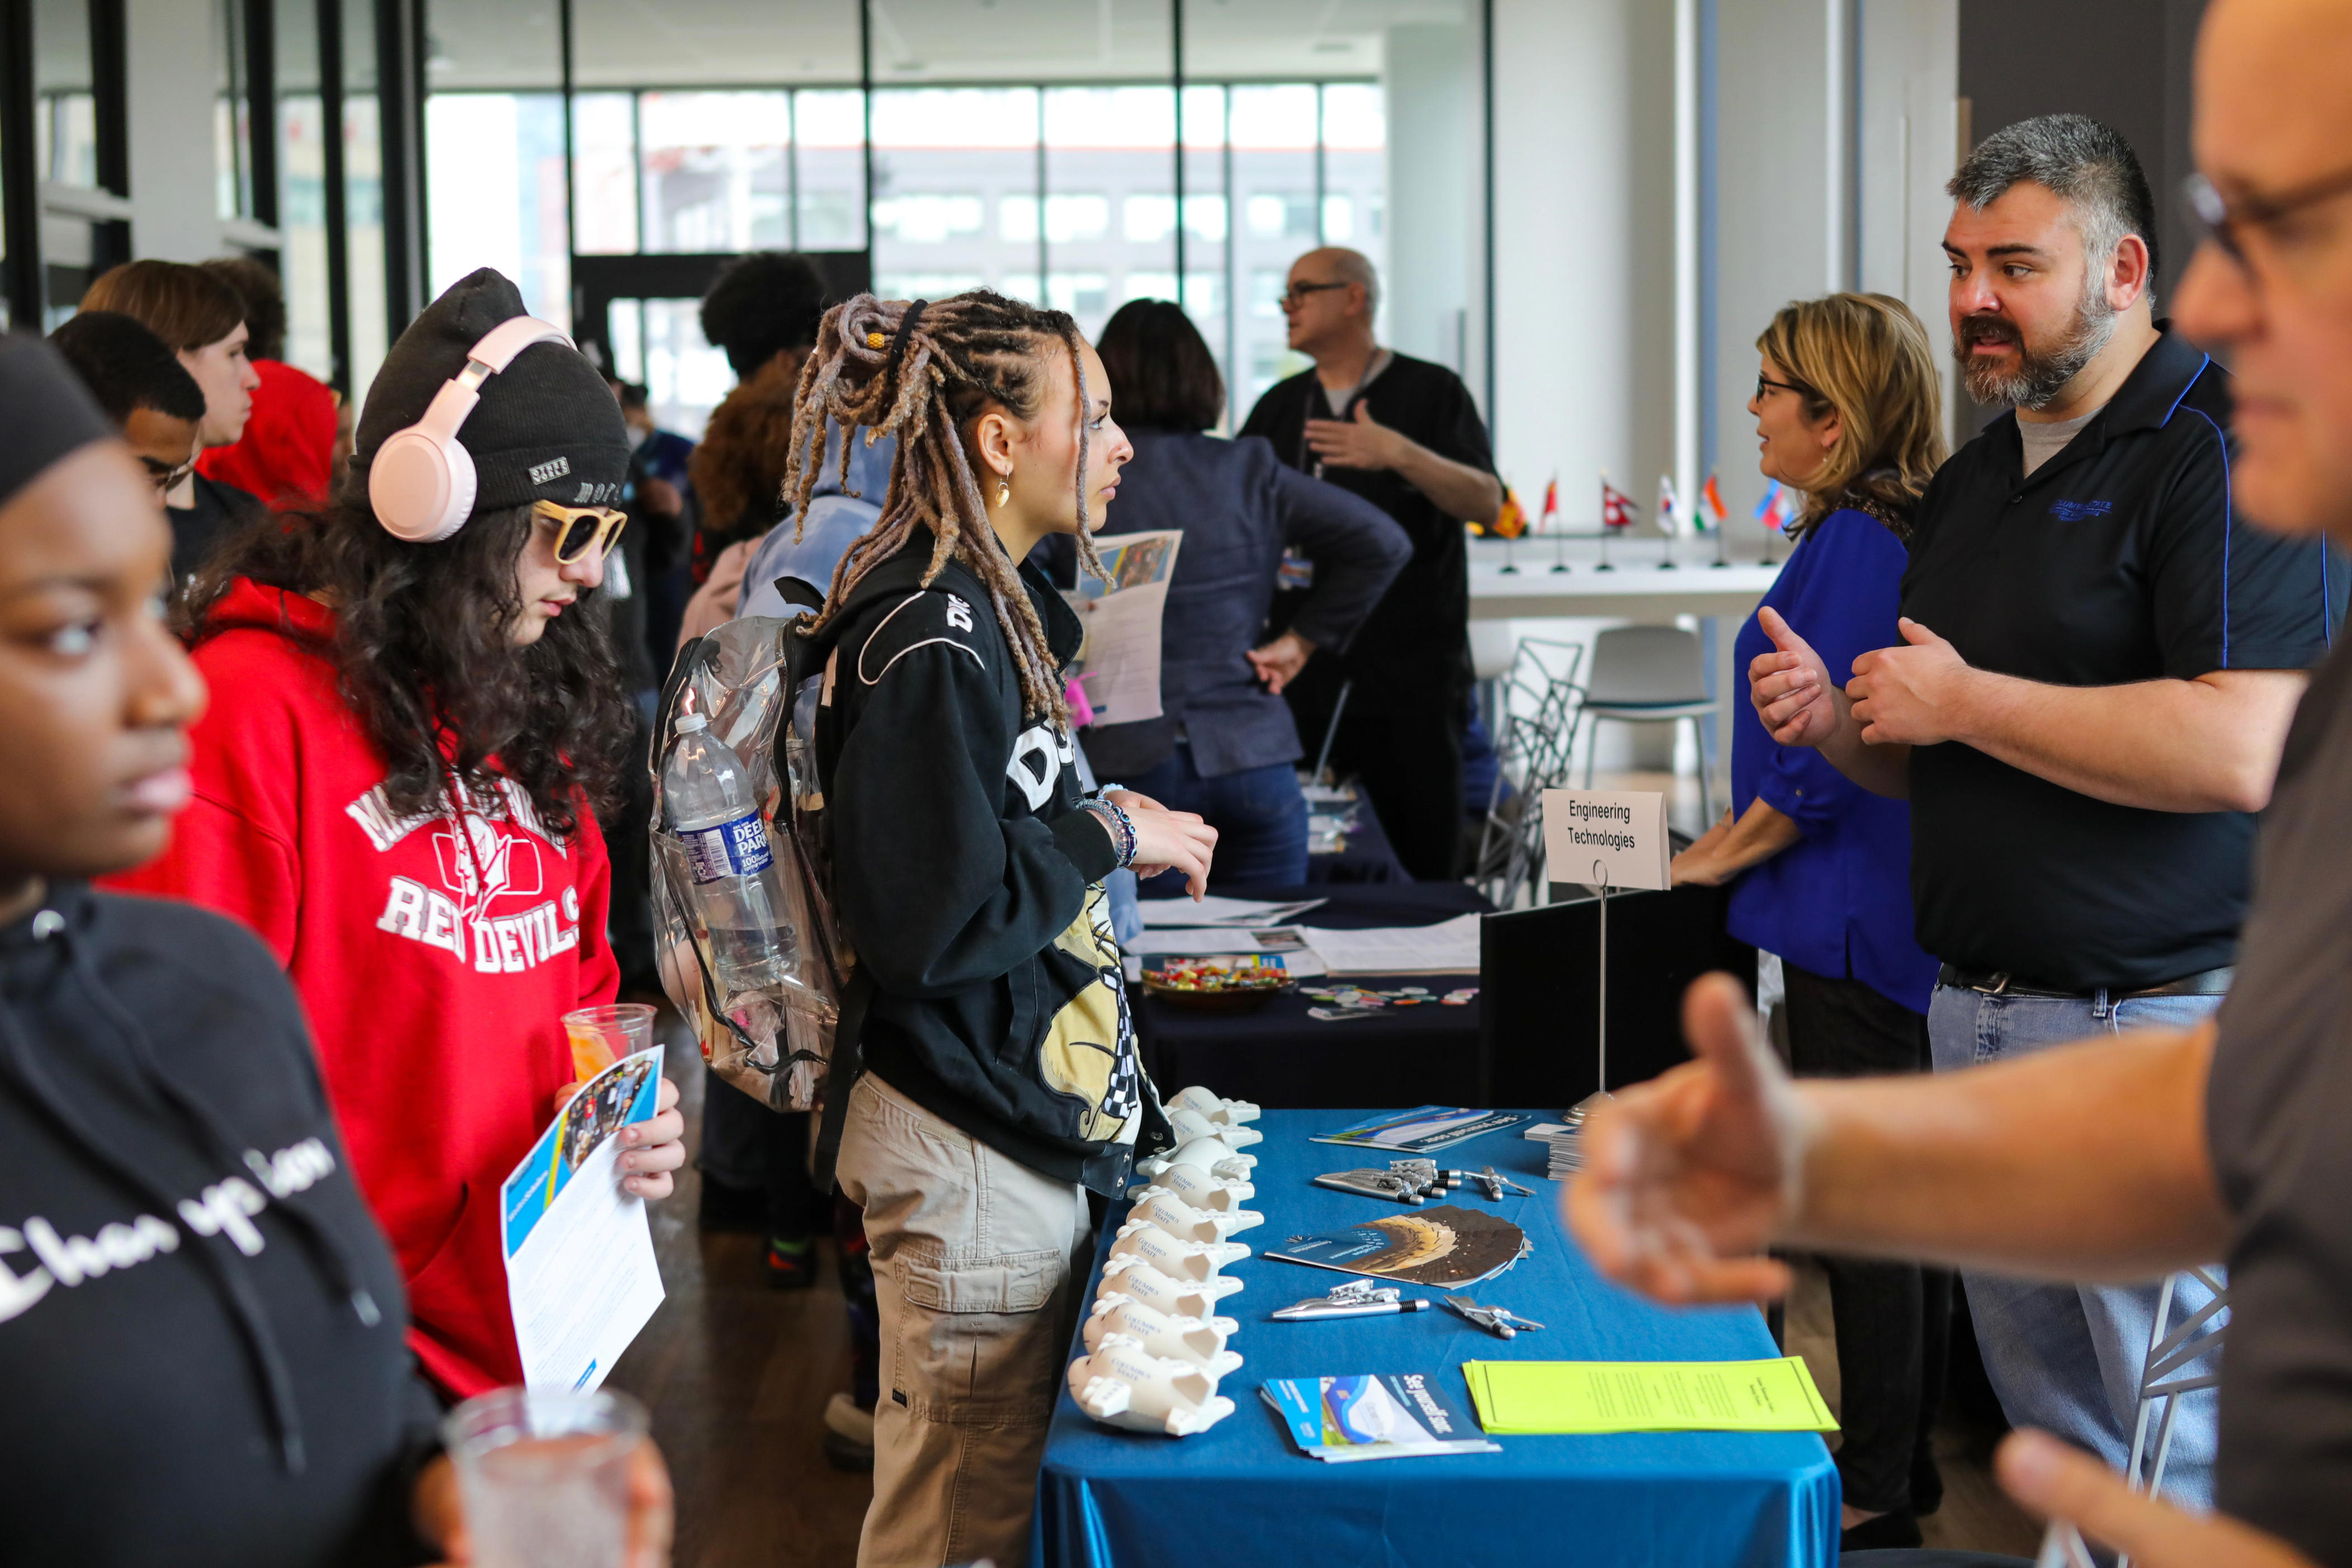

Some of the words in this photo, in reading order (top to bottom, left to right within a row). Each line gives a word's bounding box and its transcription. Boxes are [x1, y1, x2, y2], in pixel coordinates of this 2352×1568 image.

[1570, 800, 1630, 824] Engineering
[733, 818, 763, 843] DEER
[1567, 827, 1635, 851] Technologies
[738, 830, 768, 857] PARK
[1172, 1171, 1197, 1190] COLUMBUS
[1172, 1177, 1187, 1191] STATE
[1152, 1203, 1180, 1224] COLUMBUS
[1154, 1211, 1170, 1225] STATE
[1137, 1236, 1168, 1257] COLUMBUS
[1139, 1245, 1158, 1258] STATE
